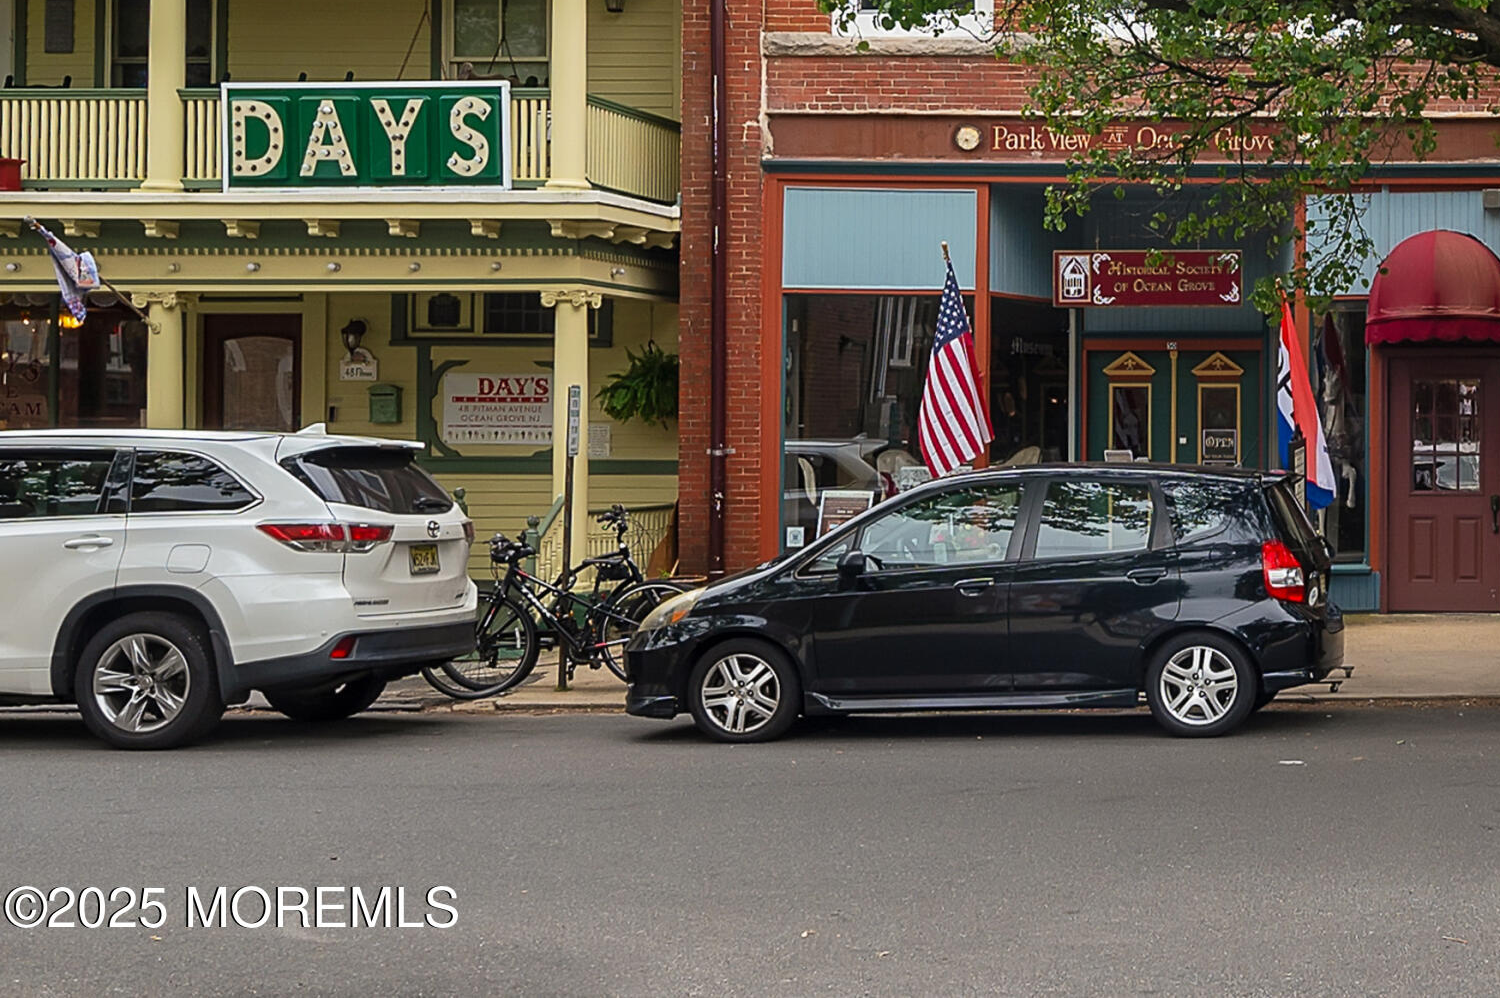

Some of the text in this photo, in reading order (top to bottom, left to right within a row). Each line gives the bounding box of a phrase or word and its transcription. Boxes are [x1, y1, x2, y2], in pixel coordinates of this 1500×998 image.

[231, 95, 492, 177] DAYS
[992, 125, 1045, 150] Park
[1042, 125, 1092, 150] View
[1108, 133, 1125, 143] AT
[478, 377, 549, 396] DAY'S
[461, 414, 541, 422] OCEAN GROVE NJ
[473, 405, 505, 413] PITMAN
[508, 405, 542, 413] AVENUE
